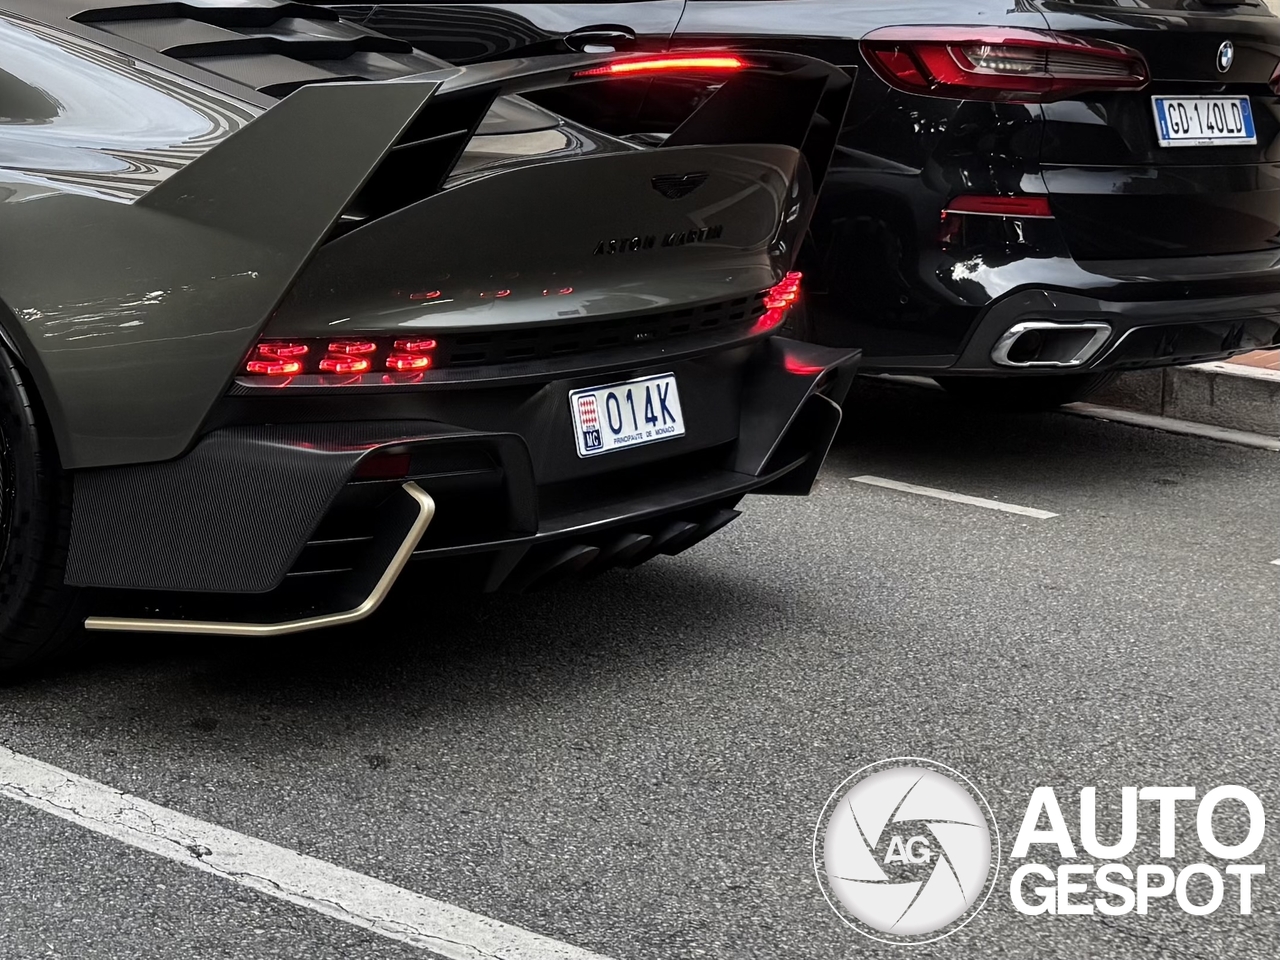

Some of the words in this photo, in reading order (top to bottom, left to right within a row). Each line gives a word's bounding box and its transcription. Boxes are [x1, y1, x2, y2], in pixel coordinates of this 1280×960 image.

[593, 236, 657, 255] ASTON
[660, 224, 724, 248] MARTIN
[605, 381, 676, 435] 014K
[585, 431, 599, 447] MC
[645, 430, 653, 438] DE
[655, 425, 676, 436] MONACO
